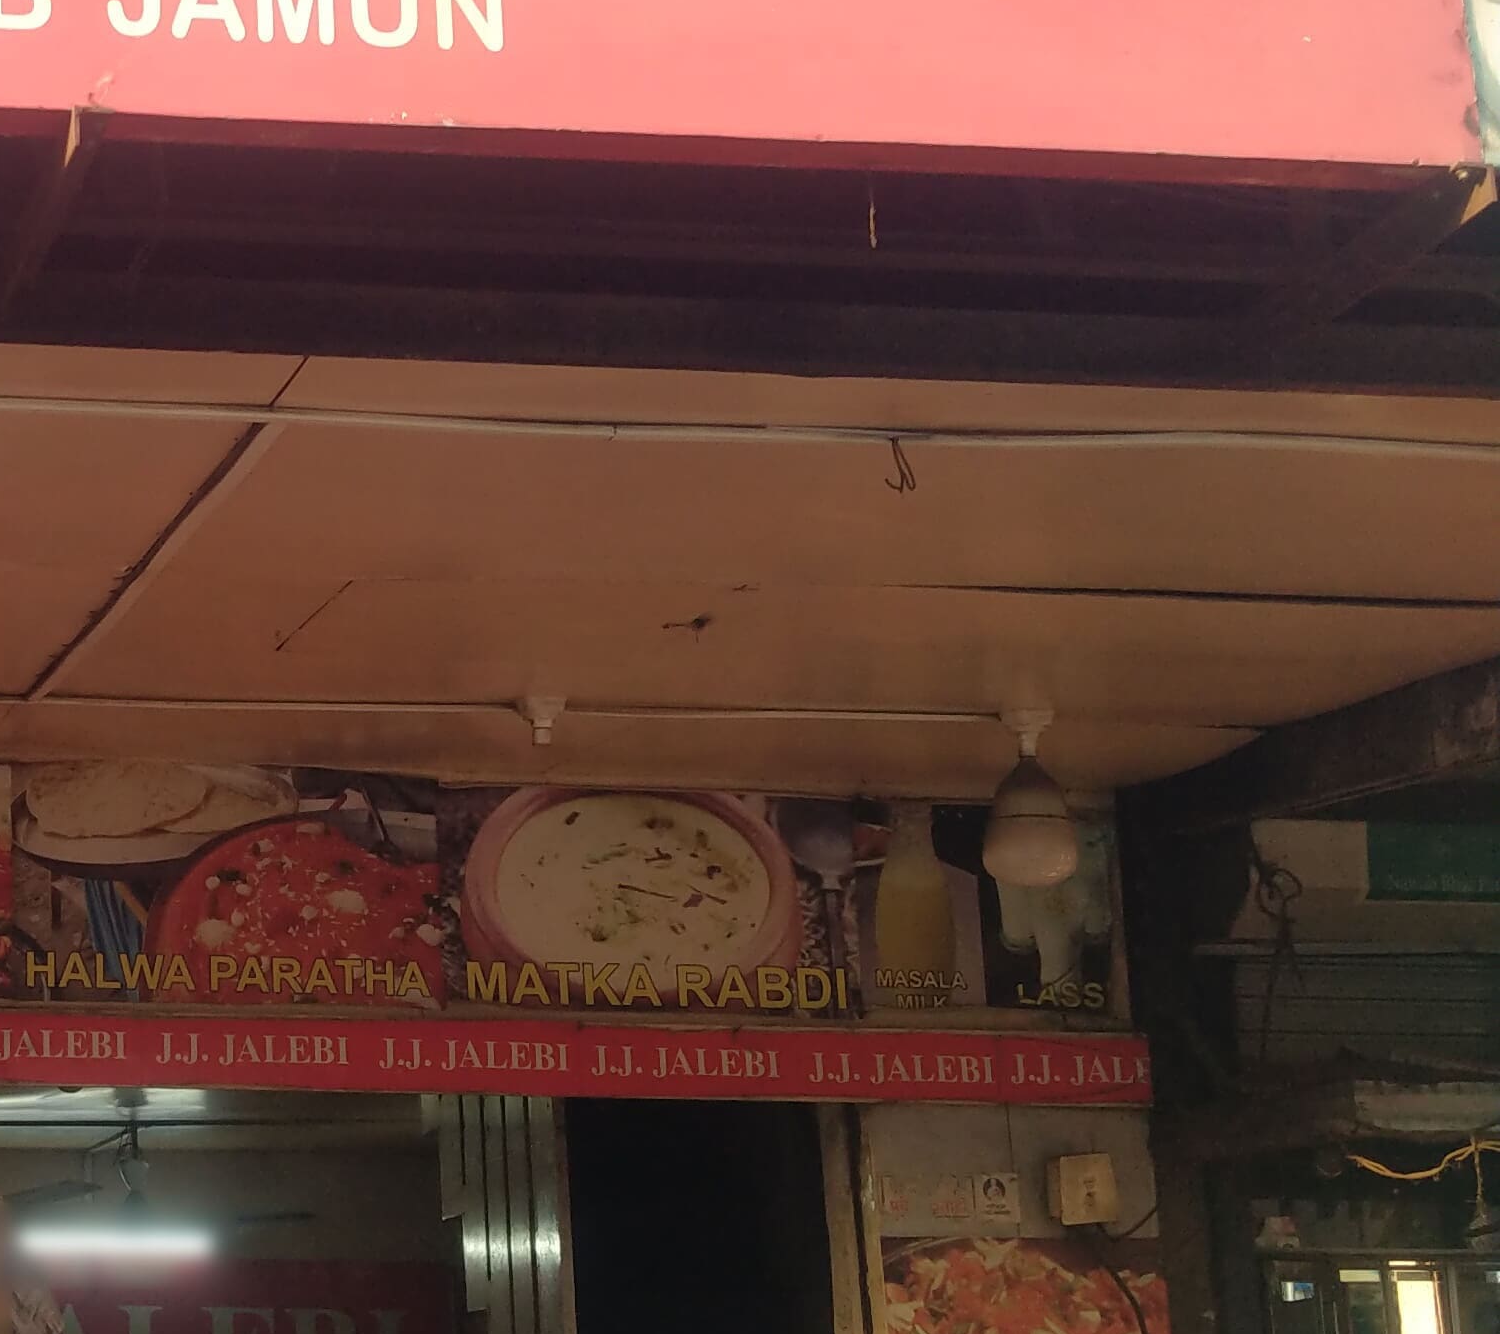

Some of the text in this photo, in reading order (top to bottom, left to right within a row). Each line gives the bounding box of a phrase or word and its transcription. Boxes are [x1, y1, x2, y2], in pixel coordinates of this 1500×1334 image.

[26, 951, 431, 998] HALWA PARATHA
[466, 960, 847, 1010] MATKA RABDI
[876, 969, 968, 991] MASALA
[896, 993, 948, 1009] MILK
[155, 1032, 208, 1064] J.J.
[218, 1034, 349, 1066] JALEBI
[378, 1036, 431, 1069] J.J.
[441, 1038, 570, 1072] JALEBI
[591, 1044, 643, 1077] J.J.
[652, 1045, 781, 1079] JALEBI
[808, 1051, 861, 1084] J.J.
[869, 1053, 996, 1085] JALEBI
[1010, 1053, 1061, 1085] J.J.
